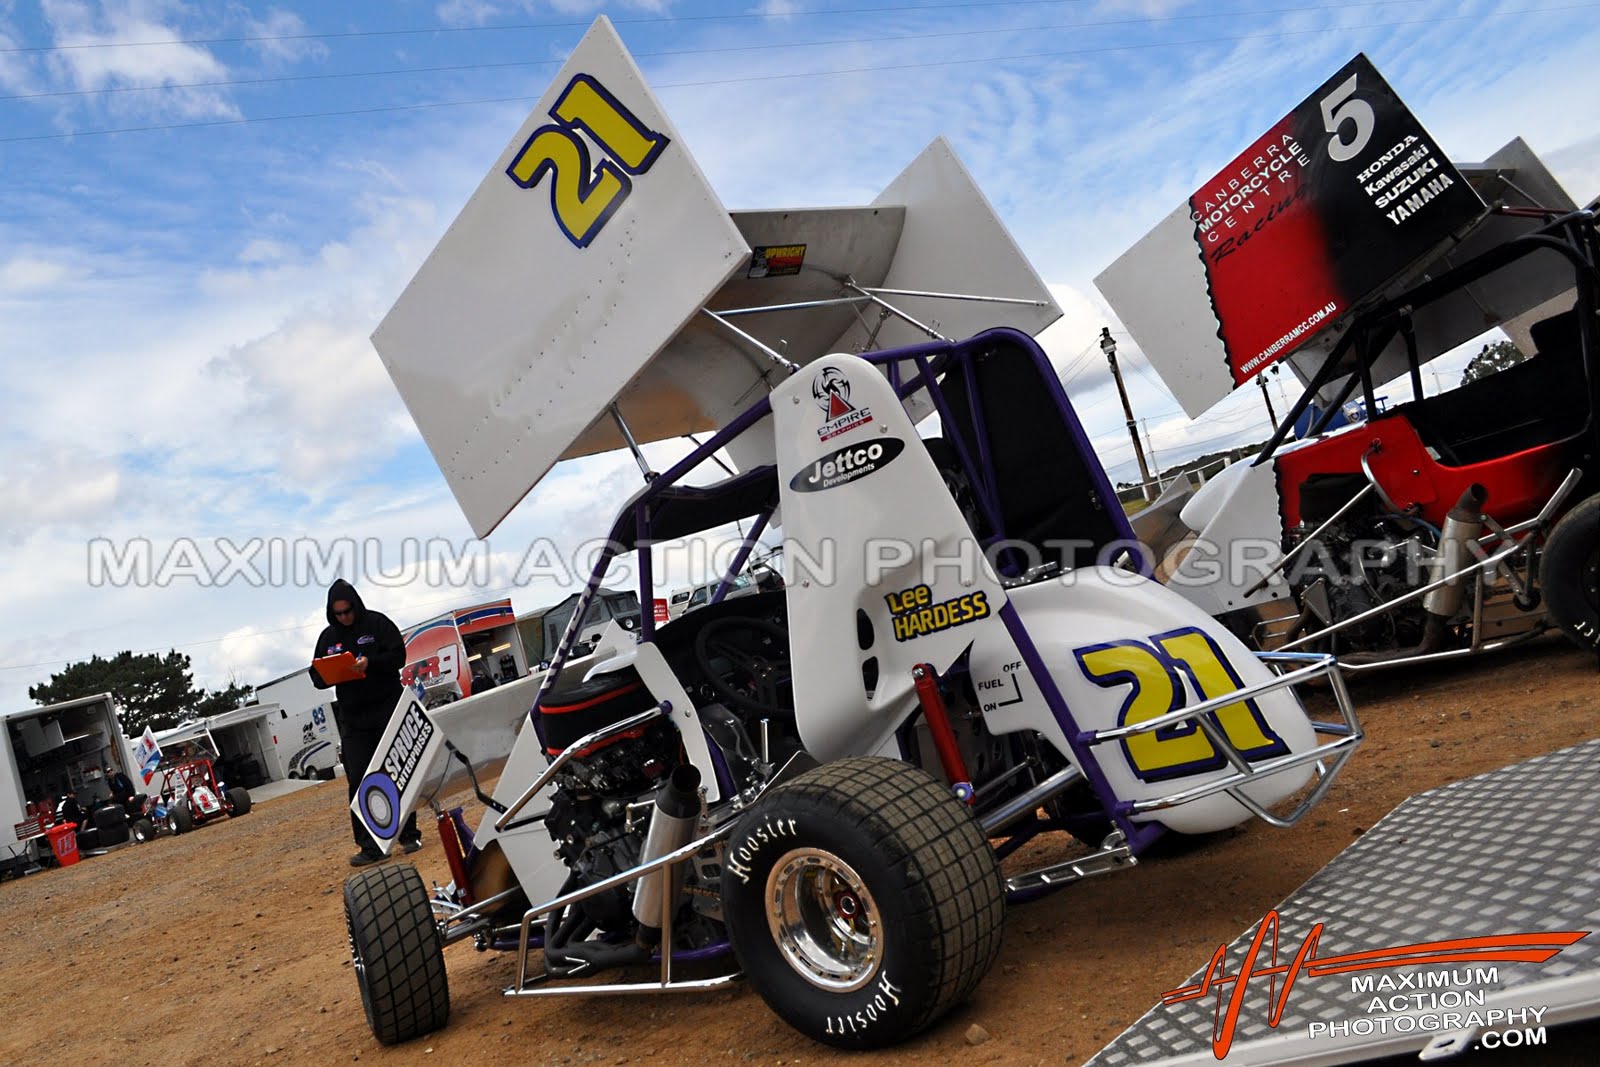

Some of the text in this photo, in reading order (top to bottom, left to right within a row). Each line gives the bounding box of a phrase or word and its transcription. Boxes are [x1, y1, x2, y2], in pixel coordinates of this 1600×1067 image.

[1320, 73, 1375, 162] 5
[505, 73, 671, 249] 21
[1191, 134, 1293, 222] CANBERRA
[1356, 134, 1419, 184] HONDA
[1364, 143, 1430, 197] Kawasaki
[1374, 157, 1439, 209] SUZUKI
[1198, 141, 1303, 233] MOTORCYCLE
[1207, 153, 1311, 243] CENTRE
[1386, 172, 1454, 225] YAMAHA
[1239, 301, 1337, 374] WWW.CANBERRAMCC.COM.AU
[817, 407, 872, 436] EMPIRE
[808, 443, 883, 484] Jettco
[823, 462, 875, 488] Developments
[884, 583, 932, 615] Lee
[892, 590, 991, 642] HARDESS
[978, 678, 1004, 691] FUEL
[1003, 661, 1022, 673] OFF
[312, 706, 326, 726] 83
[983, 702, 997, 712] ON
[1072, 626, 1293, 784] 21
[384, 703, 424, 782] SPRUCE
[396, 721, 432, 791] ENTERPRISES
[727, 815, 797, 885] Hoosier
[825, 970, 902, 1034] Hoosier
